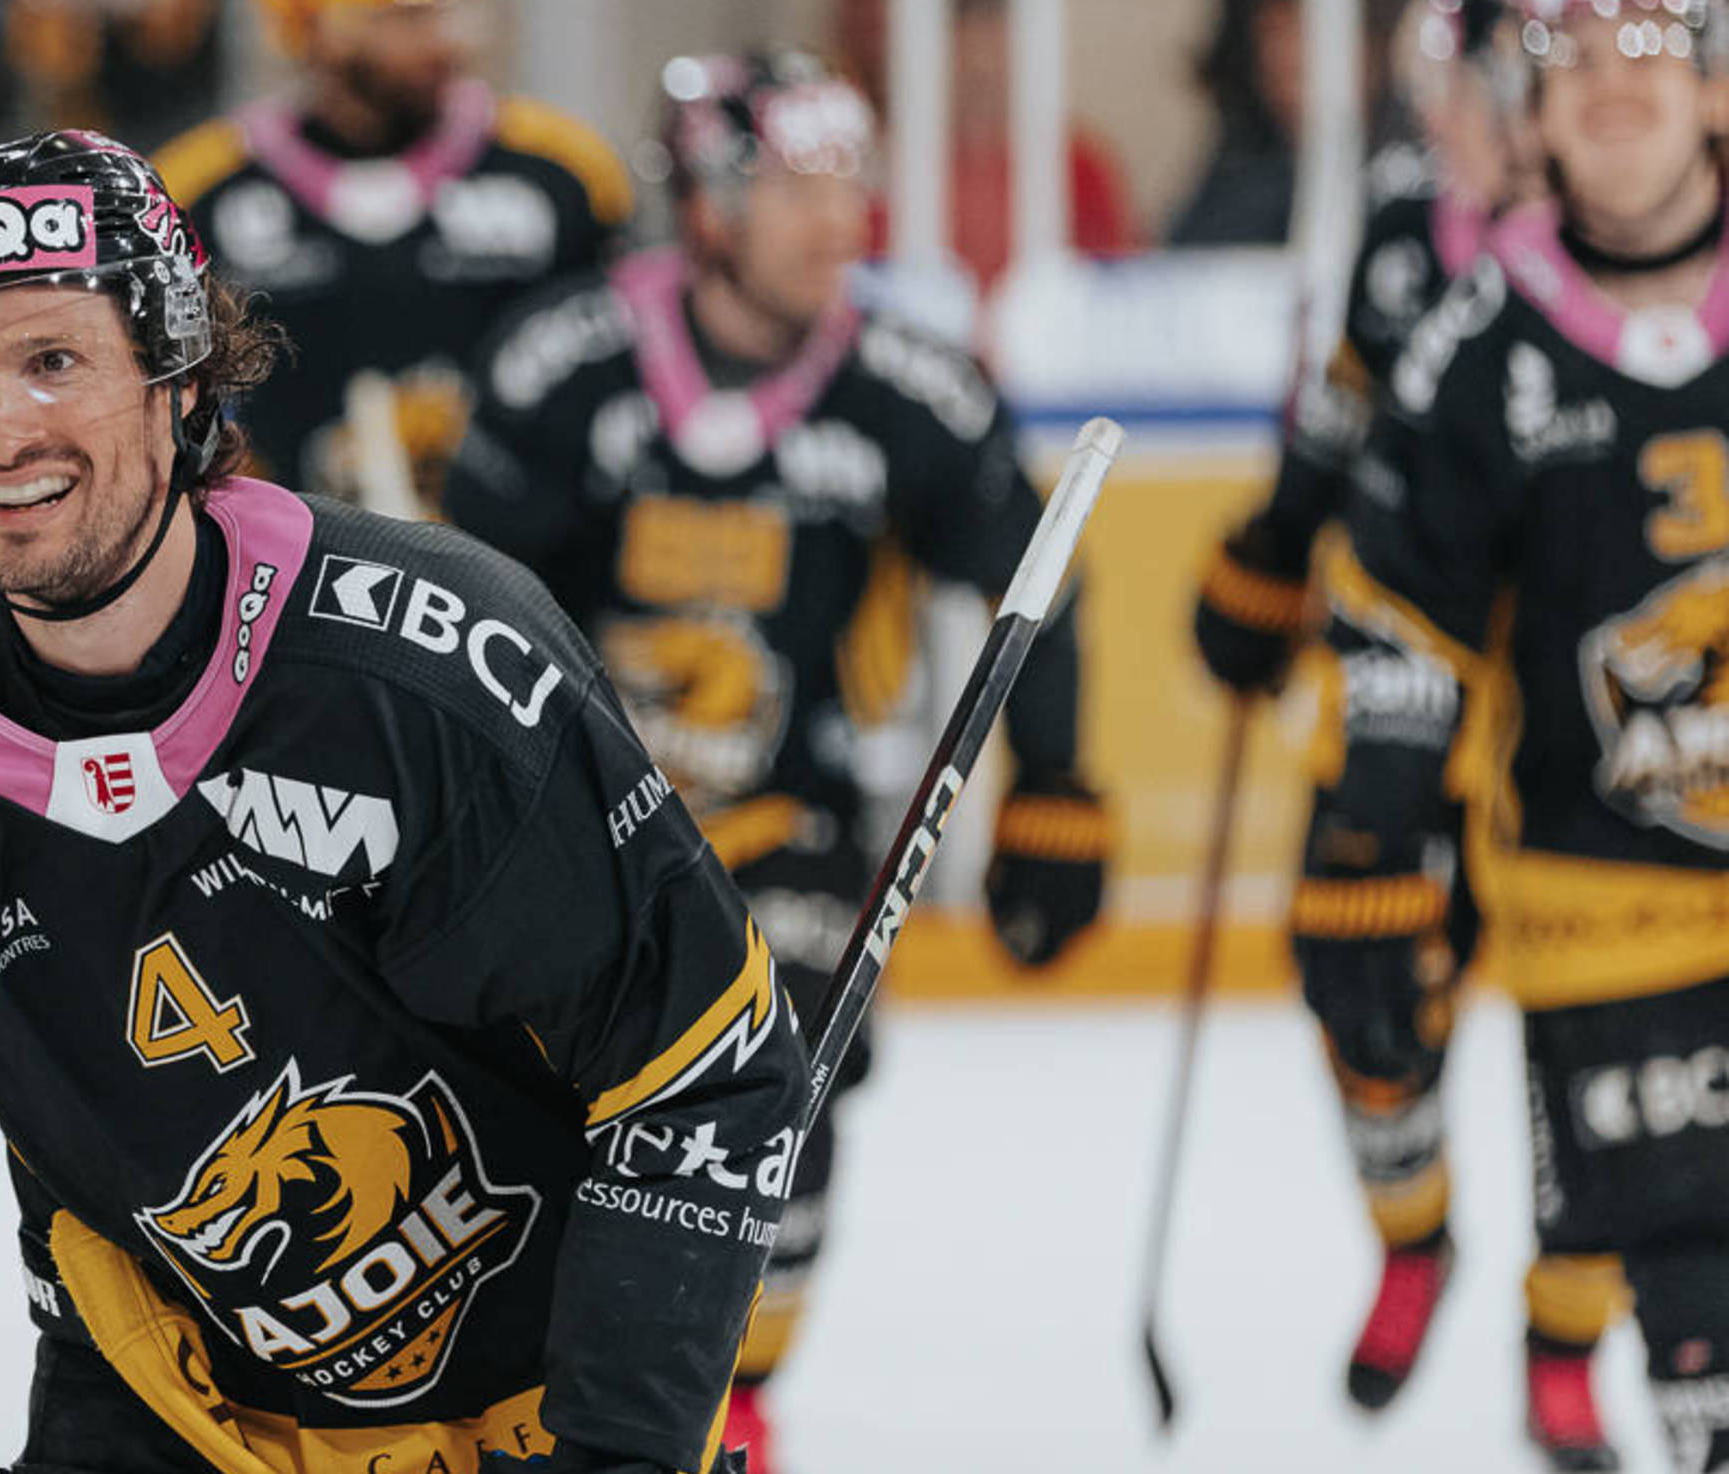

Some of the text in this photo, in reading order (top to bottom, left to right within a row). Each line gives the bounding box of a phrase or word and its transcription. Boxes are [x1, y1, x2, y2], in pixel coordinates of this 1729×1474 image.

[233, 563, 278, 685] QoQa
[399, 577, 564, 729] BCJ
[0, 897, 39, 938] SA
[864, 763, 963, 970] CCM
[126, 931, 257, 1074] 4
[232, 1162, 509, 1363] AJOIE
[295, 1255, 483, 1390] HOCKEY CLUB
